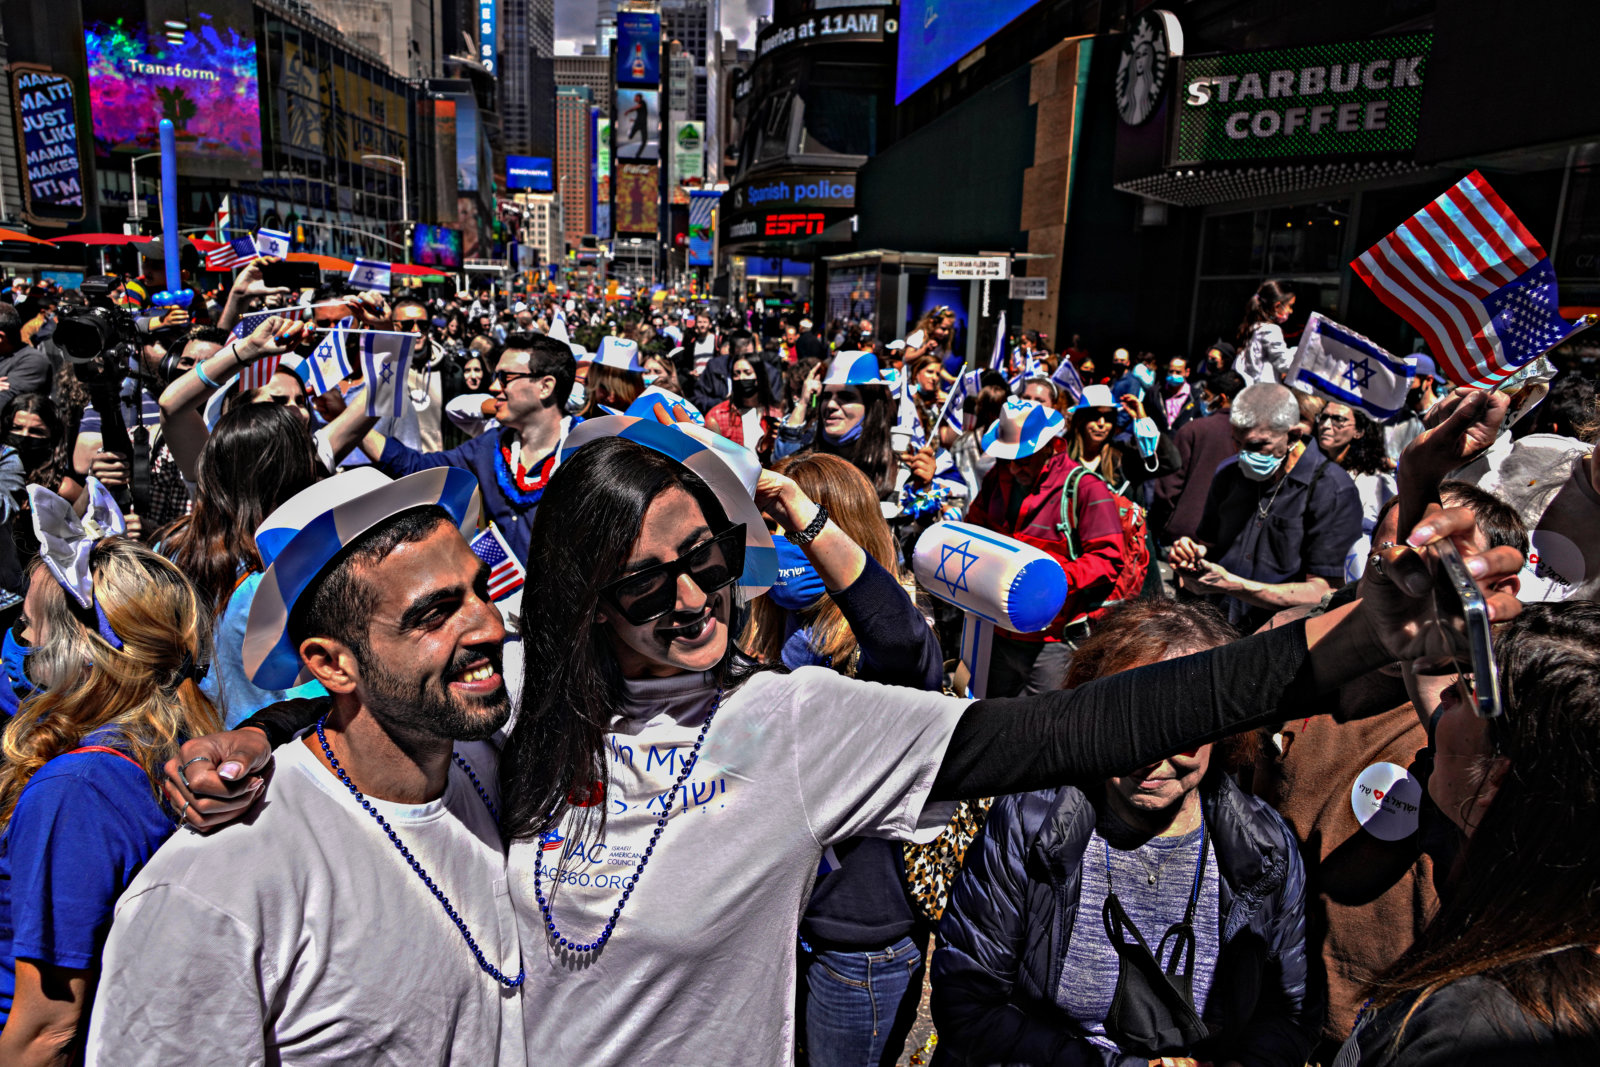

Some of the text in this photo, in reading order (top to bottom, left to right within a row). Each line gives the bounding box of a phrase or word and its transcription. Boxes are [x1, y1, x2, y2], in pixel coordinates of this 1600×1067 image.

[797, 18, 816, 40] at
[820, 13, 880, 36] 11AM
[18, 73, 64, 89] MAK
[128, 59, 220, 81] Transform.
[1187, 54, 1425, 106] STARBUCK
[47, 83, 73, 101] IT!
[23, 108, 67, 132] JUST
[1225, 100, 1389, 140] COFFEE
[26, 143, 74, 165] MAMA
[28, 157, 79, 181] MAKES
[32, 180, 59, 198] IT!
[747, 181, 790, 206] Spanish
[794, 180, 856, 203] police
[764, 212, 826, 236] ESPN
[646, 746, 699, 780] My
[564, 838, 607, 864] IAC
[607, 859, 636, 867] COUNCIL
[536, 864, 635, 890] AC360.ORG
